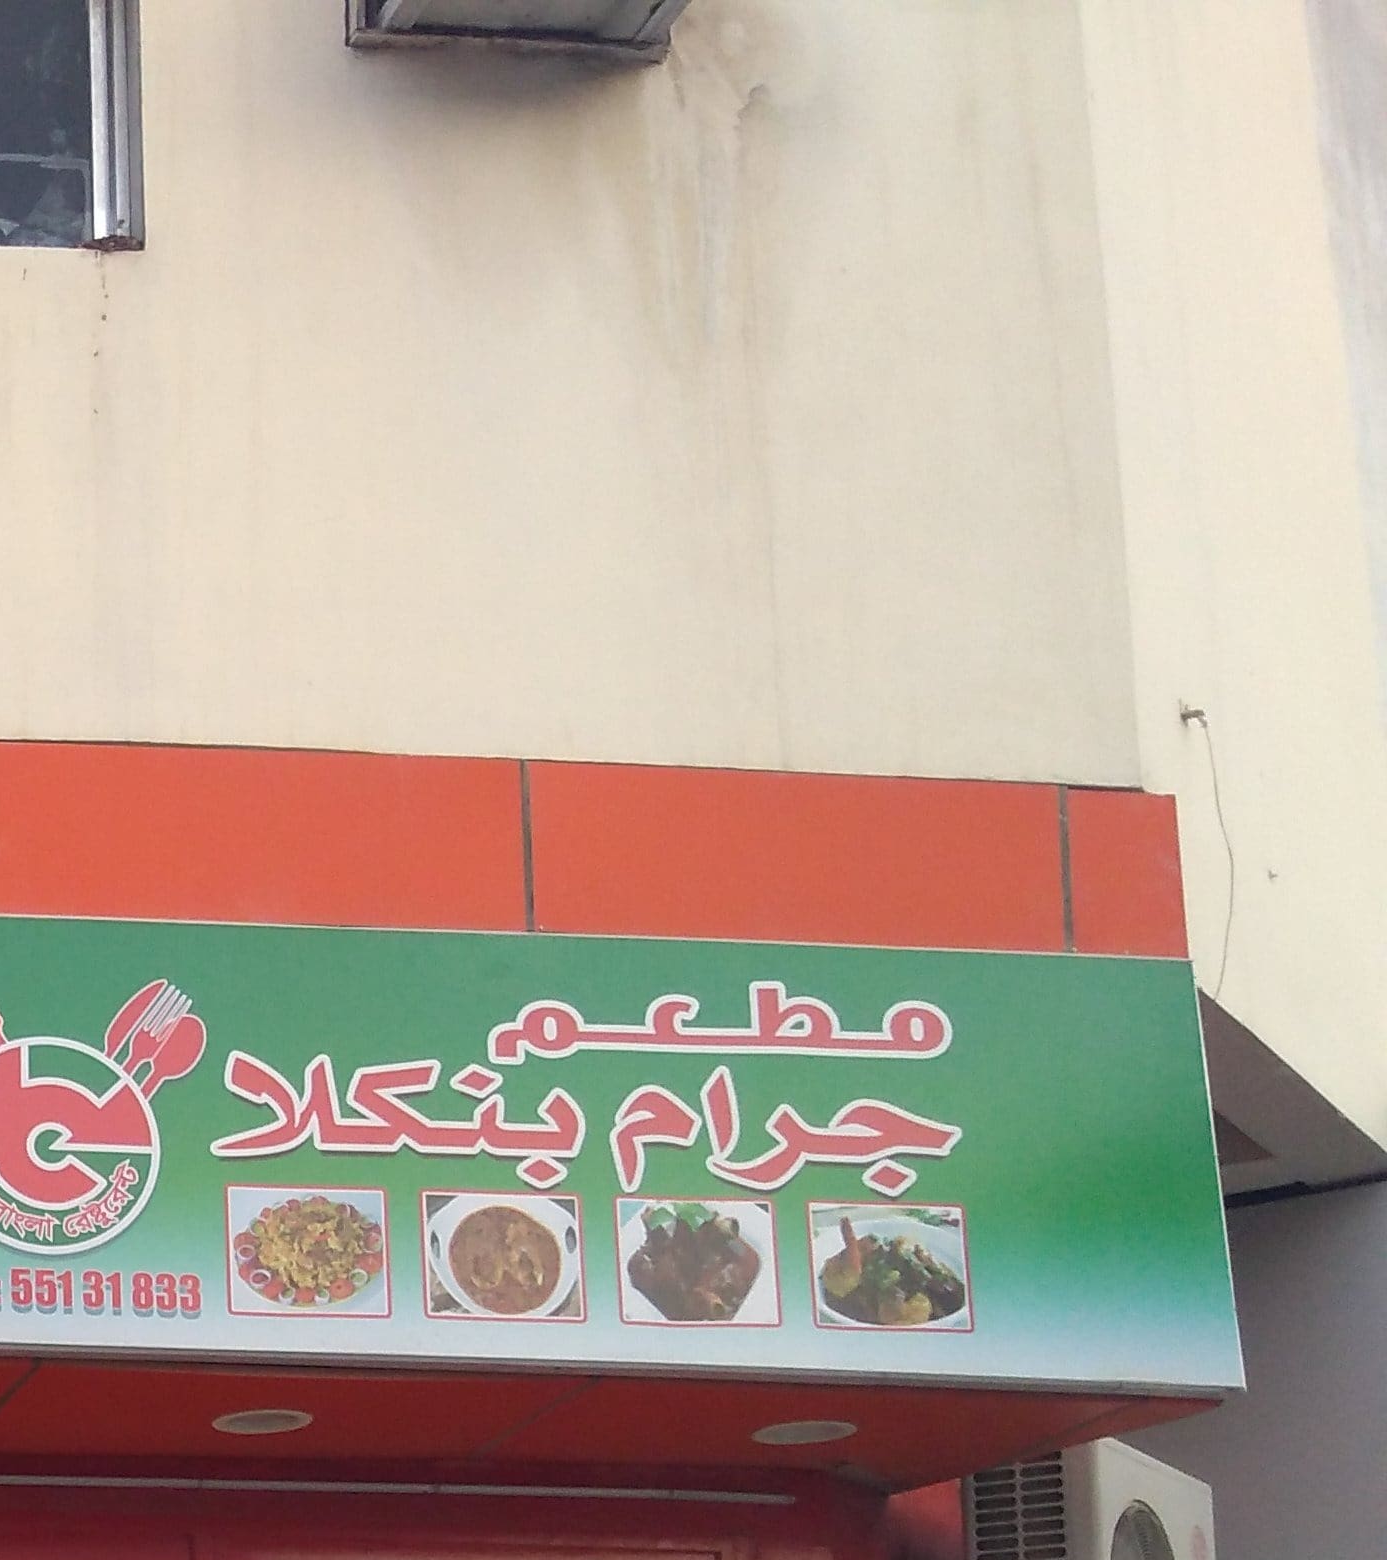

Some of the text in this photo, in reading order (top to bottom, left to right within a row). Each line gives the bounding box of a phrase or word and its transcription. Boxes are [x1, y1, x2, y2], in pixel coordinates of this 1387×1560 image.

[486, 981, 950, 1060] مطعم
[211, 1051, 961, 1193] جرام بنكلا
[9, 1267, 74, 1313] 551
[81, 1269, 122, 1314] 31
[131, 1271, 202, 1318] 833
